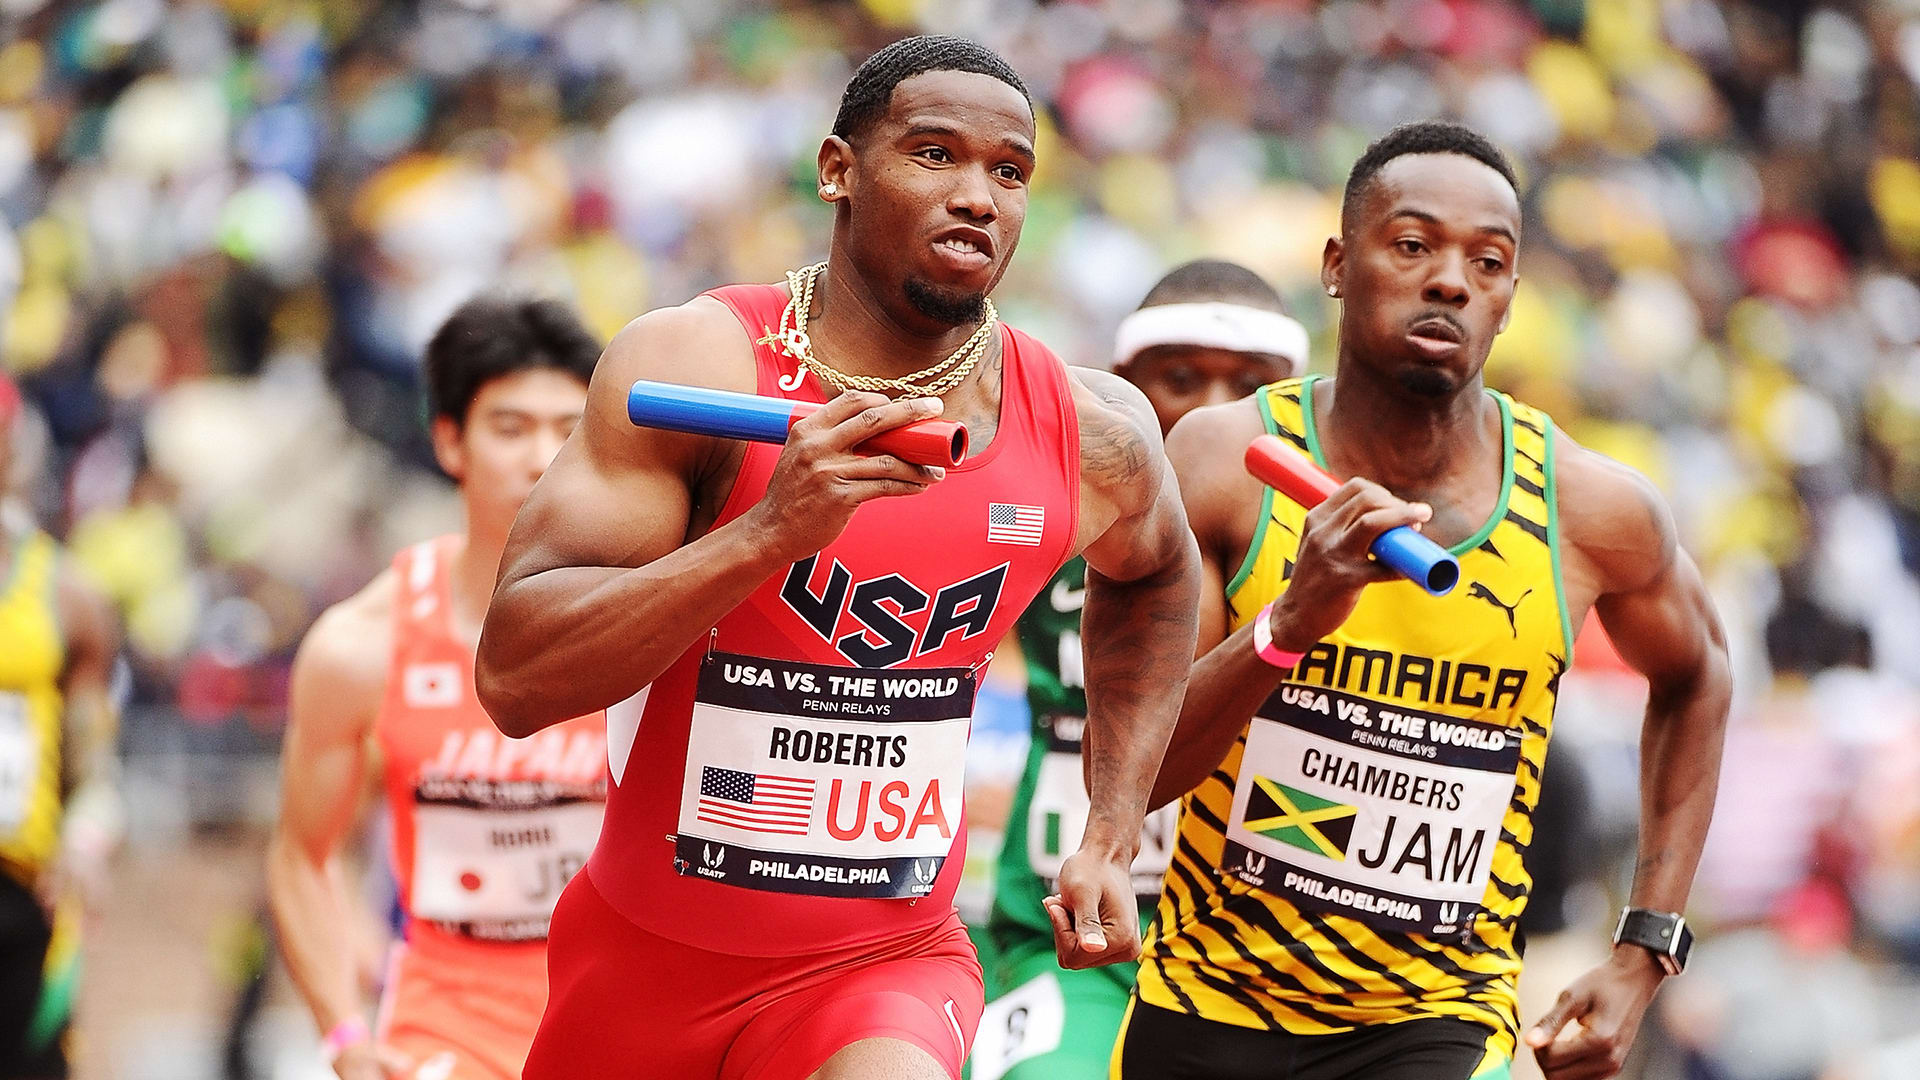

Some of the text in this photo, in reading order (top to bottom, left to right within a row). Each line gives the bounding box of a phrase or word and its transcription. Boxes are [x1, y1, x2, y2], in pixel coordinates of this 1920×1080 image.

[779, 551, 1011, 669] USA
[723, 664, 959, 699] USA VS. THE WORLD
[1288, 643, 1528, 709] AMAICA
[803, 700, 891, 716] PENN RELAYS
[1281, 687, 1507, 751] USA VS. THE WORLD
[769, 726, 907, 768] ROBERTS
[1351, 730, 1437, 759] PENN RELAYS
[1301, 748, 1463, 812] CHAMBERS
[826, 779, 952, 842] USA
[697, 866, 726, 879] USATF
[749, 860, 891, 884] PHILADELPHIA
[1358, 815, 1486, 884] JAM
[911, 884, 935, 894] USAT
[1284, 871, 1422, 922] PHILADELPHIA
